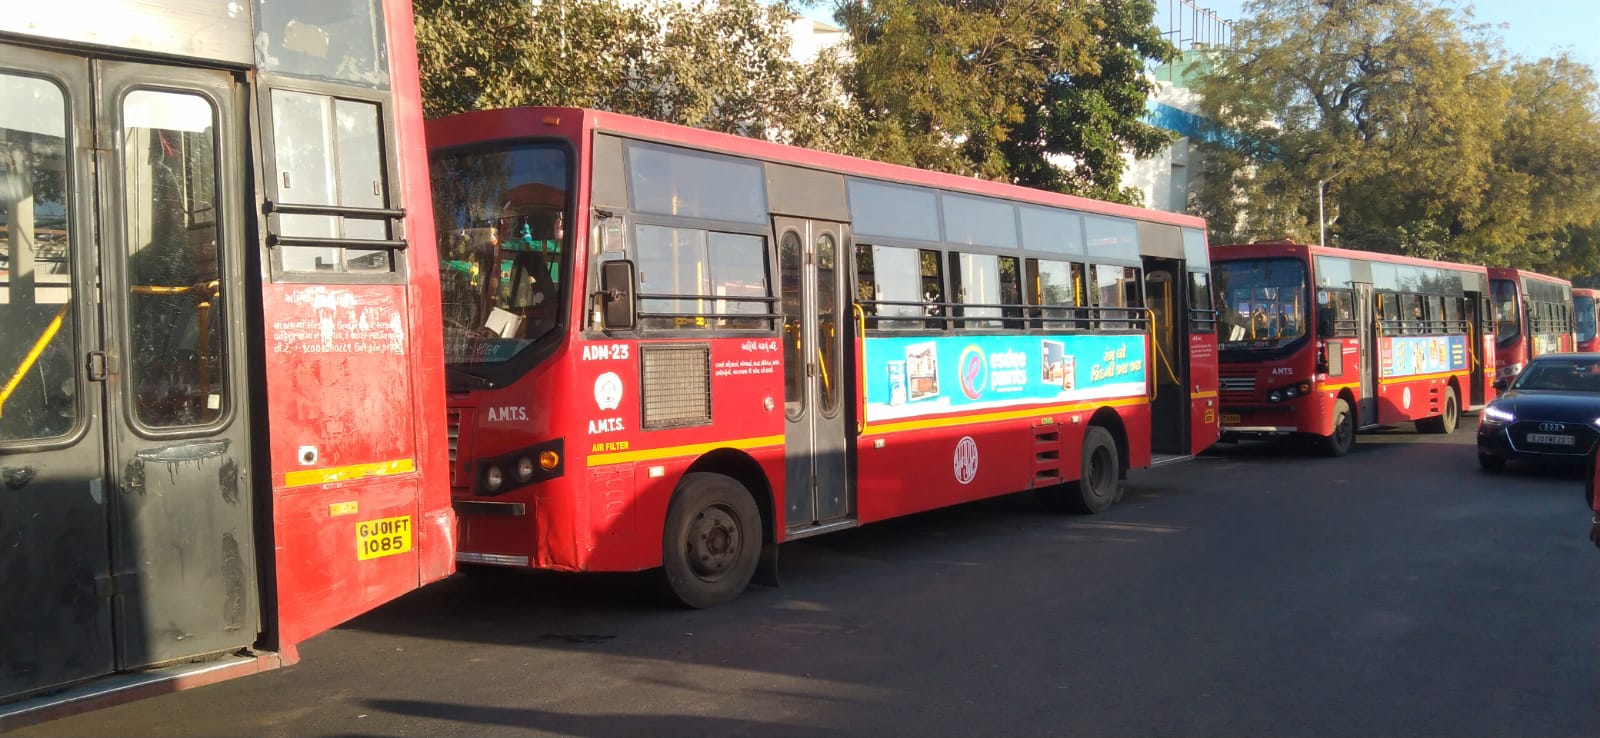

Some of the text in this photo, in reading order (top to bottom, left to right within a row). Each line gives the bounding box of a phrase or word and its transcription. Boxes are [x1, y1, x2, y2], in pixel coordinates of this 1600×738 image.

[582, 344, 629, 361] ADM-23
[989, 351, 1027, 369] esdee
[991, 369, 1028, 392] paints
[488, 406, 529, 421] A.M.T.S.
[588, 418, 625, 435] A.M.T.S.
[592, 441, 629, 452] AIR FILTER
[364, 536, 403, 555] 1085
